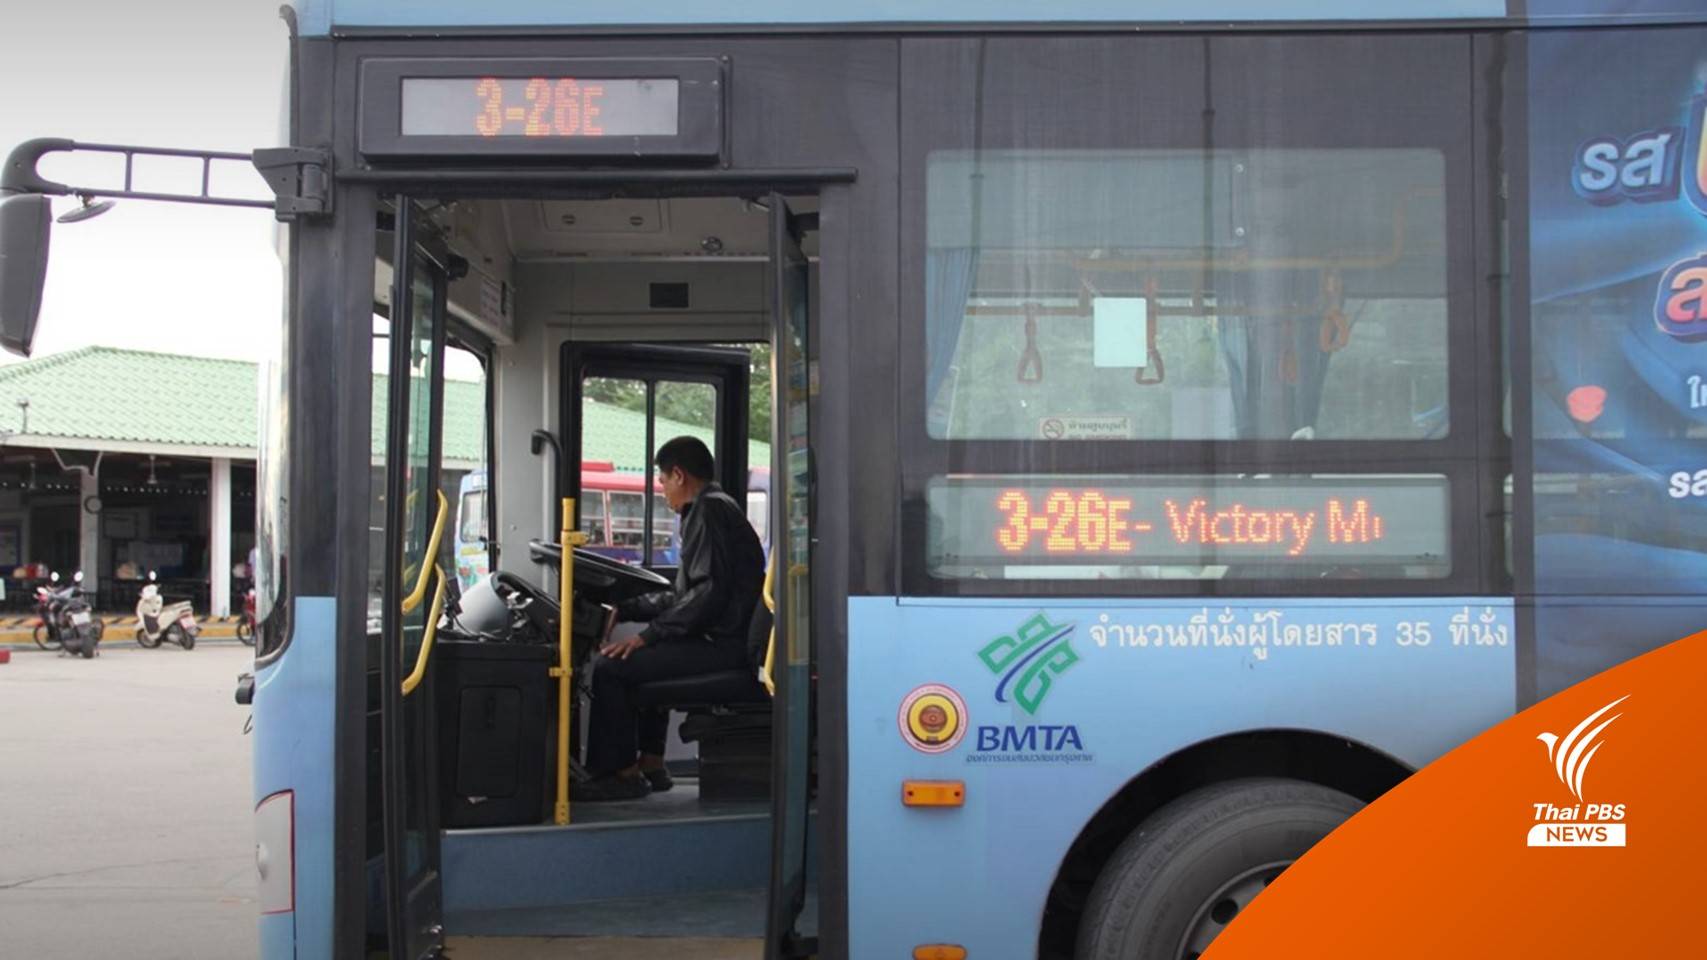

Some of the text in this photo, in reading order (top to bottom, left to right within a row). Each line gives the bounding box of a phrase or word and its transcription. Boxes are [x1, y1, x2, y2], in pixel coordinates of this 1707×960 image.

[476, 78, 603, 136] 3-26E
[1165, 499, 1315, 556] Victory
[1089, 606, 1509, 661] จำนวนที่นั่งผู้โดยสาร 35 ที่นั่ง
[976, 725, 1084, 752] BMTA
